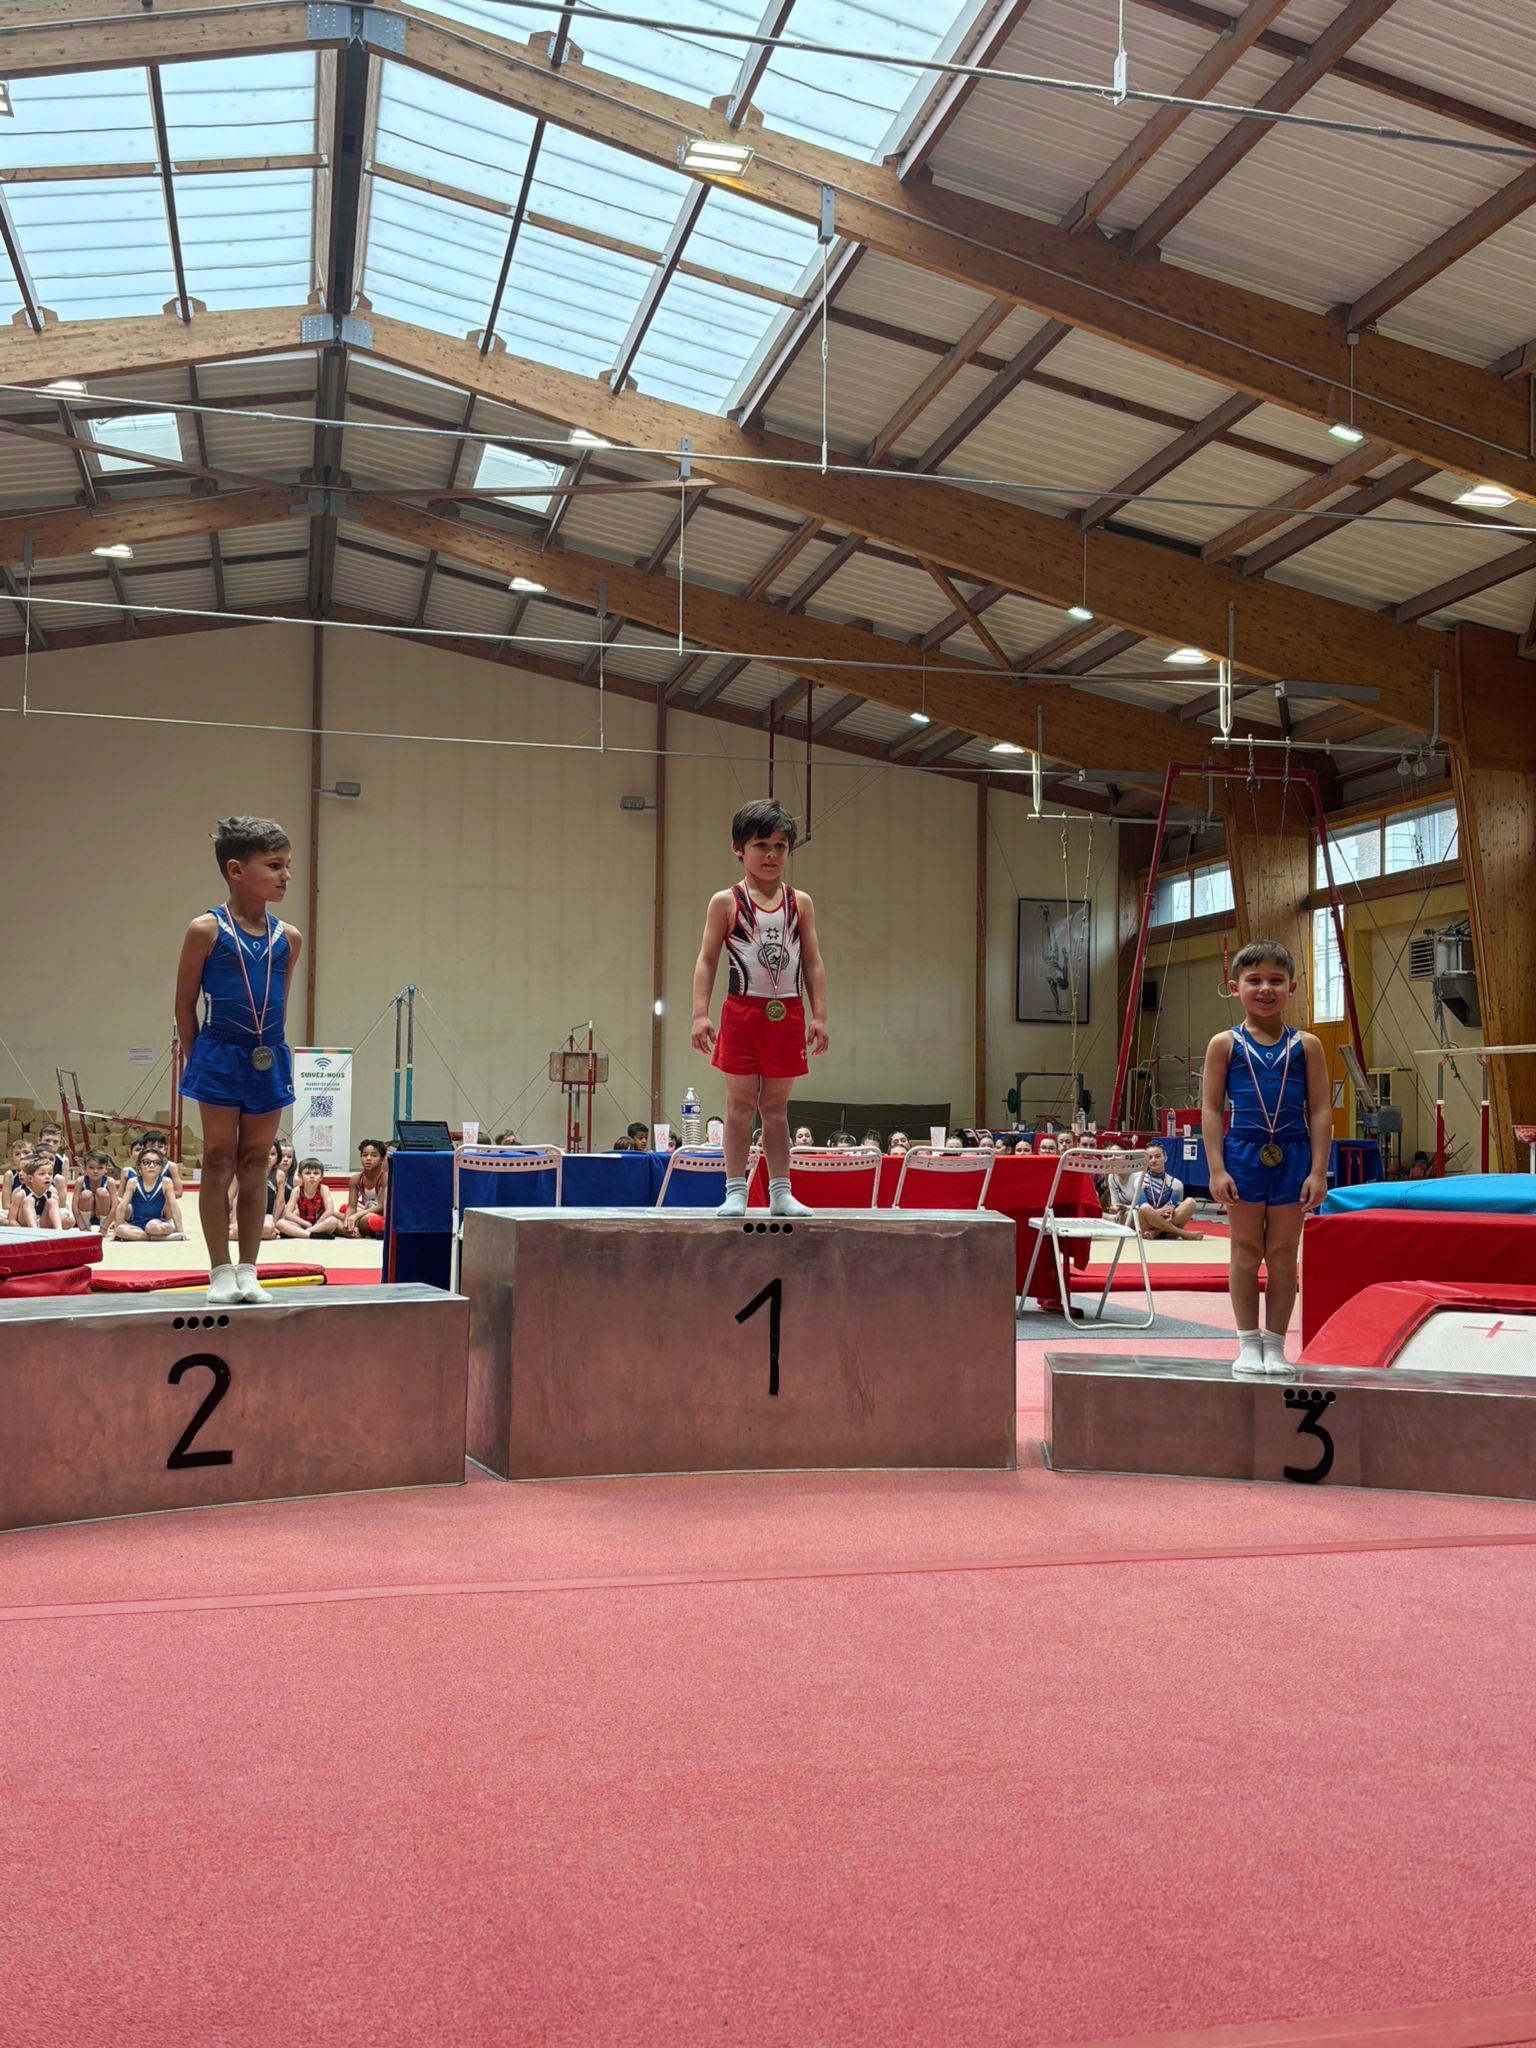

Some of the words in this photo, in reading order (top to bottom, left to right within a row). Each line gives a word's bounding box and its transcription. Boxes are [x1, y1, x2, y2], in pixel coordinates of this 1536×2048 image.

[735, 1278, 782, 1395] 1
[167, 1354, 232, 1469] 2
[1284, 1398, 1335, 1484] 3
